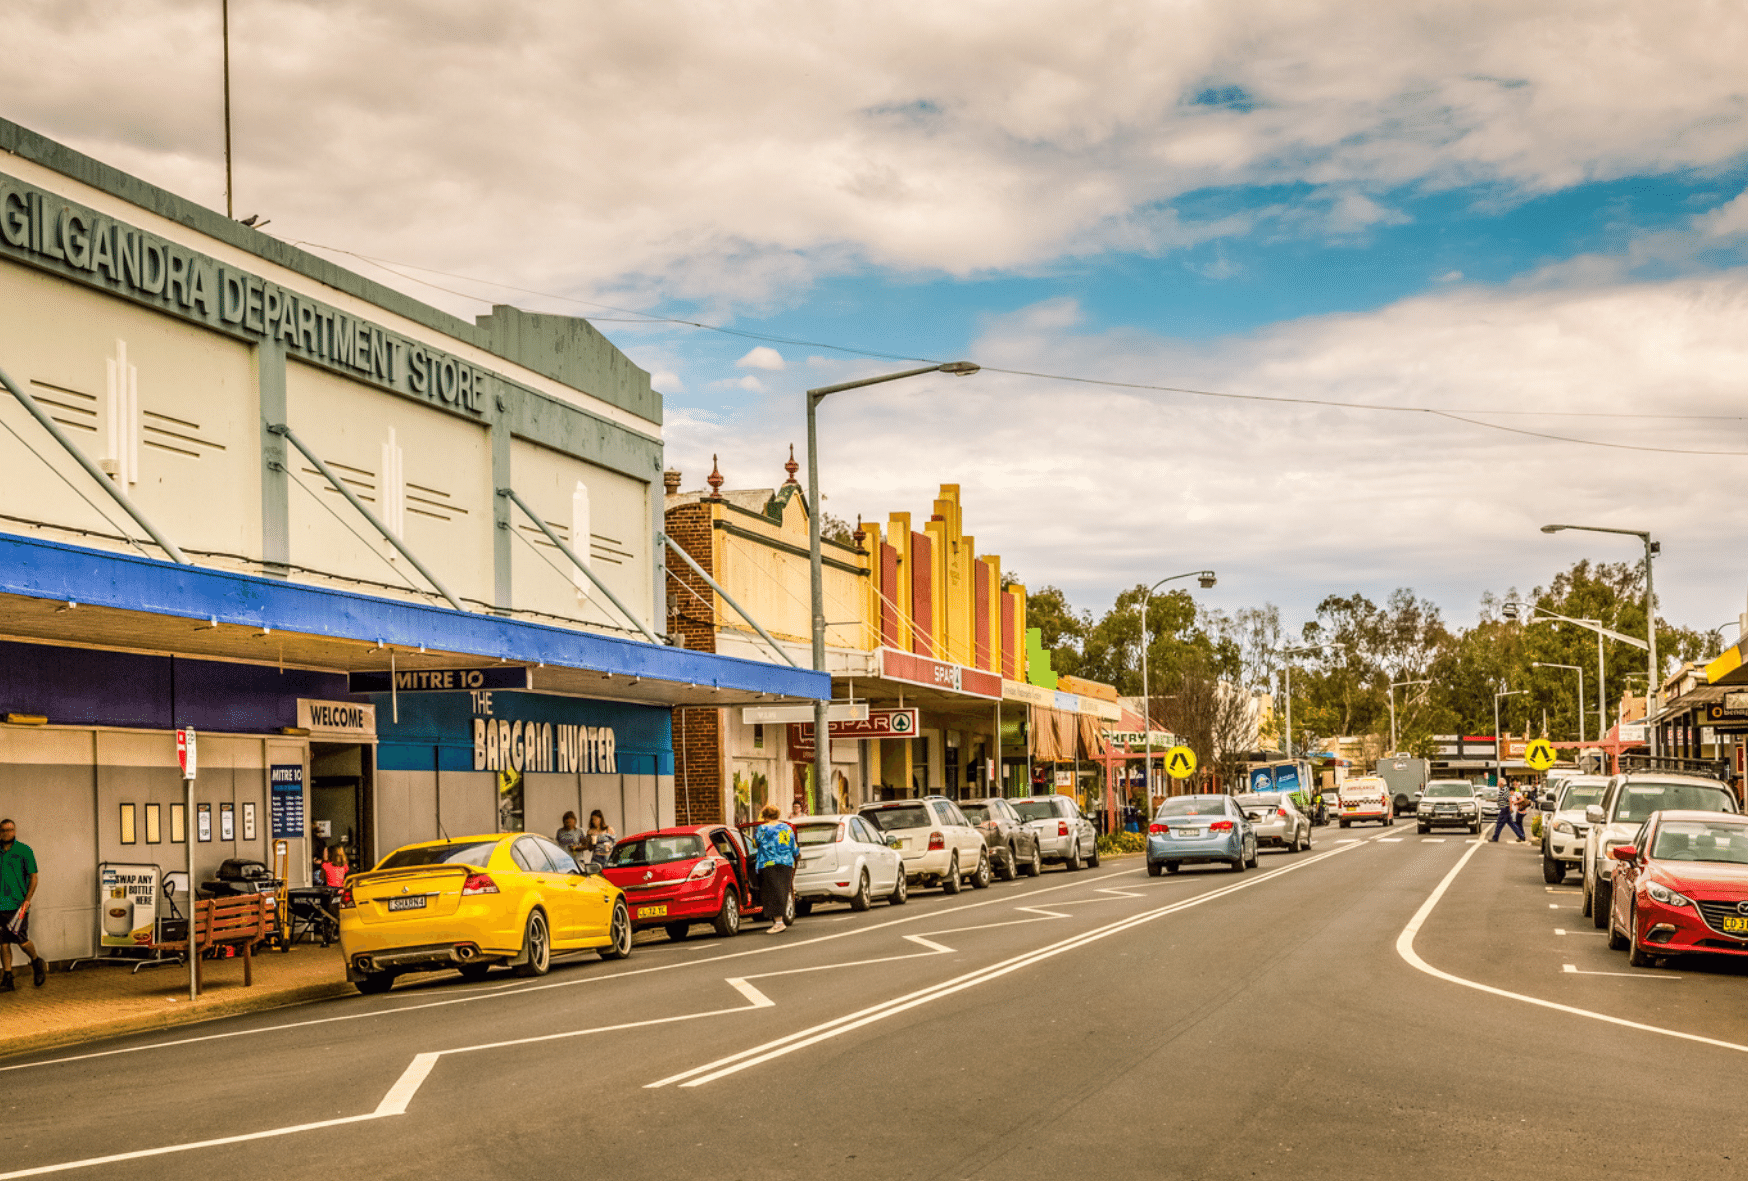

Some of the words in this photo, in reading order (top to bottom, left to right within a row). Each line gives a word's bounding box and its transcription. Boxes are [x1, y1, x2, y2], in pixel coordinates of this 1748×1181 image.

[2, 193, 206, 313] GILGANDRA
[219, 268, 401, 381] DEPARTMENT
[409, 344, 485, 412] STORE
[396, 671, 453, 690] MITRE
[460, 670, 483, 687] 10
[934, 665, 954, 684] SPAR
[470, 691, 493, 715] THE
[309, 704, 363, 728] WELCOME
[473, 718, 552, 771] BARGAIN
[557, 724, 616, 773] HUNTER
[272, 769, 293, 782] MITRE
[294, 769, 302, 781] 10
[115, 875, 136, 884] SWAP
[138, 875, 153, 884] ANY
[129, 886, 153, 895] BOTTLE
[136, 896, 153, 905] HERE
